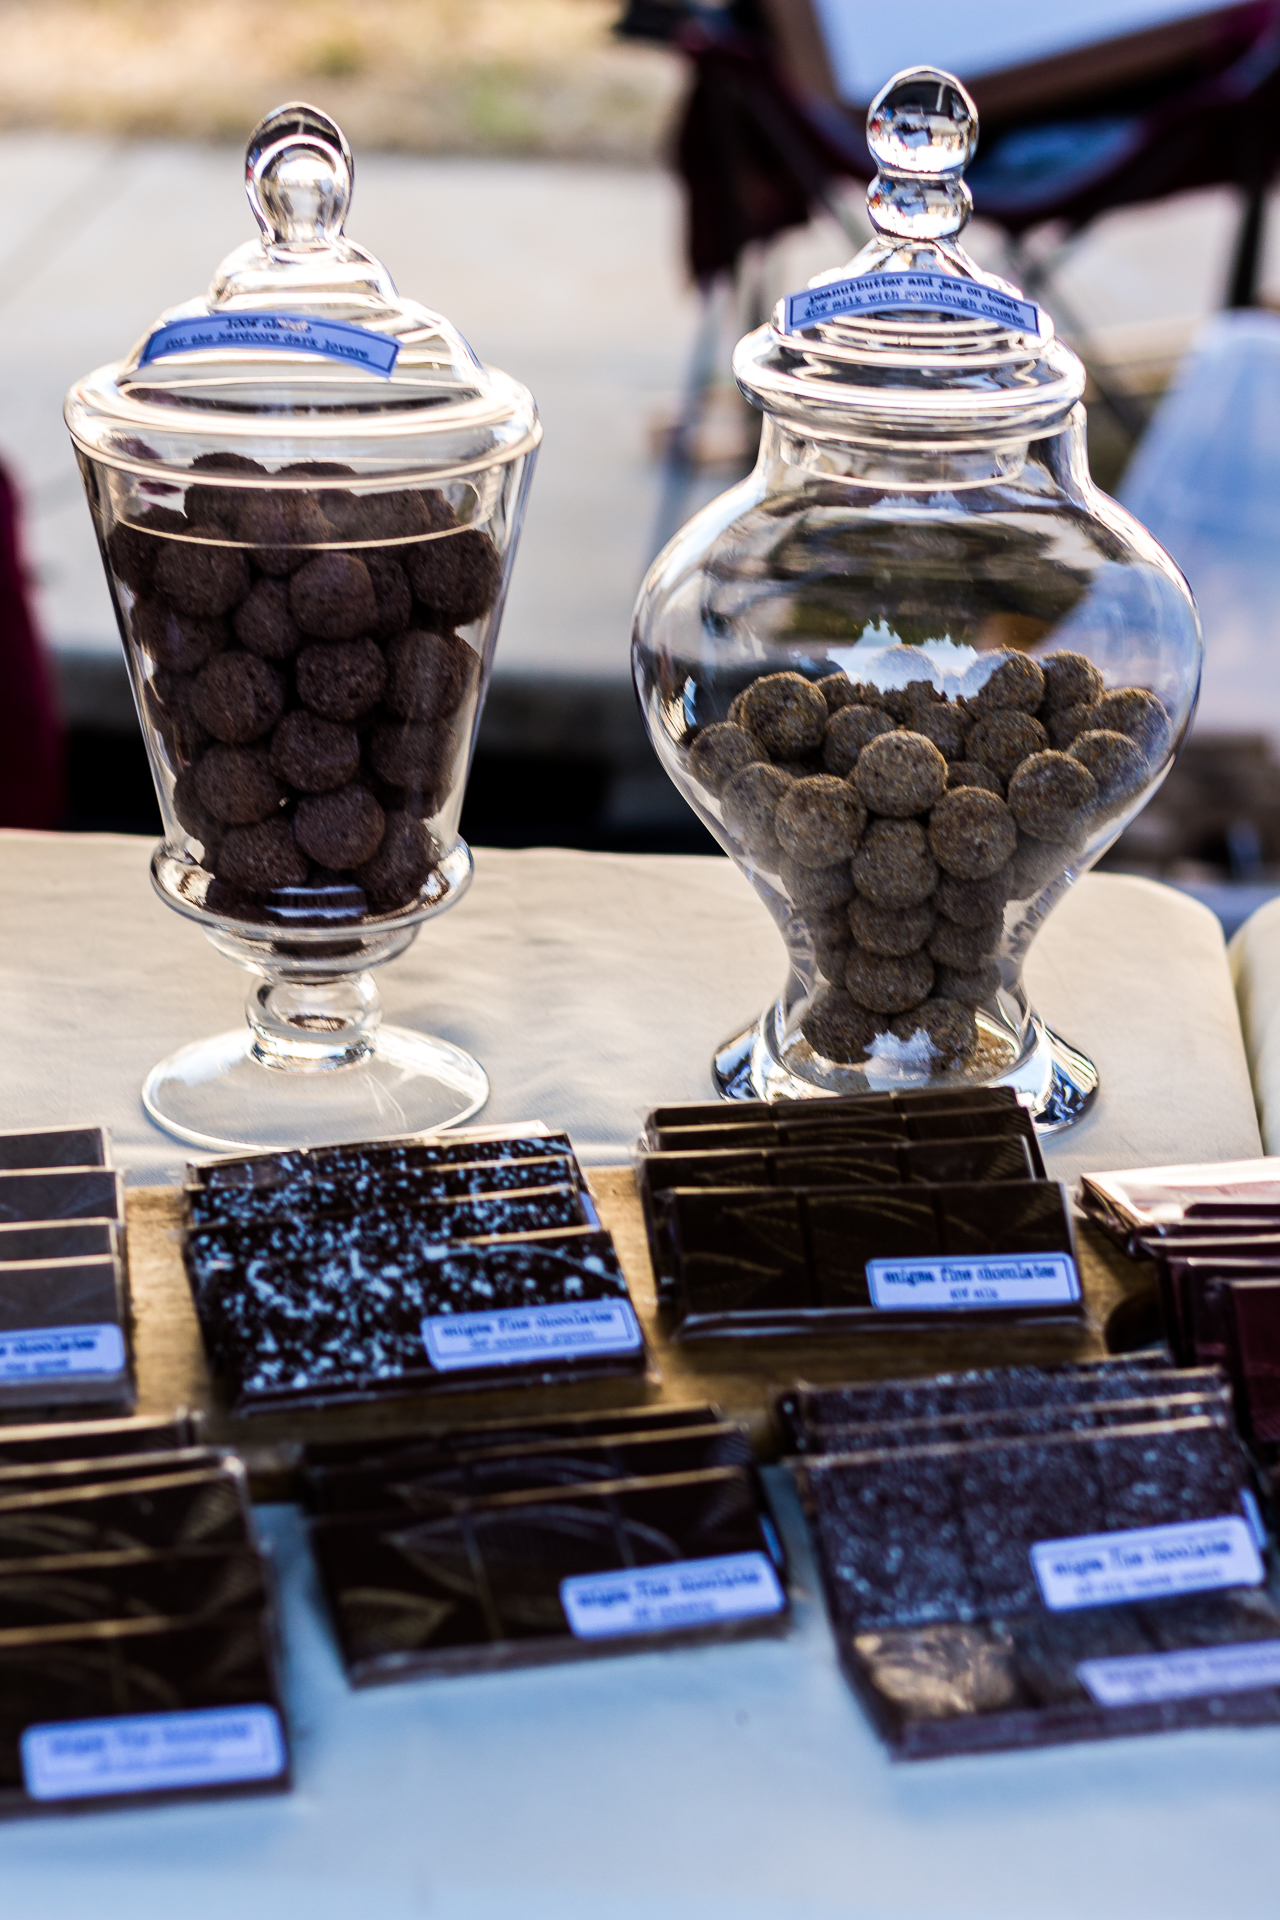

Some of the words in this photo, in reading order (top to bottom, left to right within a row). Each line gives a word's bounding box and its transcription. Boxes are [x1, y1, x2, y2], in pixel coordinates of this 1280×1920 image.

[808, 275, 904, 306] peanutbutter
[908, 275, 934, 289] and
[938, 278, 963, 294] jam
[966, 285, 983, 299] on
[867, 288, 900, 303] with
[283, 332, 319, 348] dark
